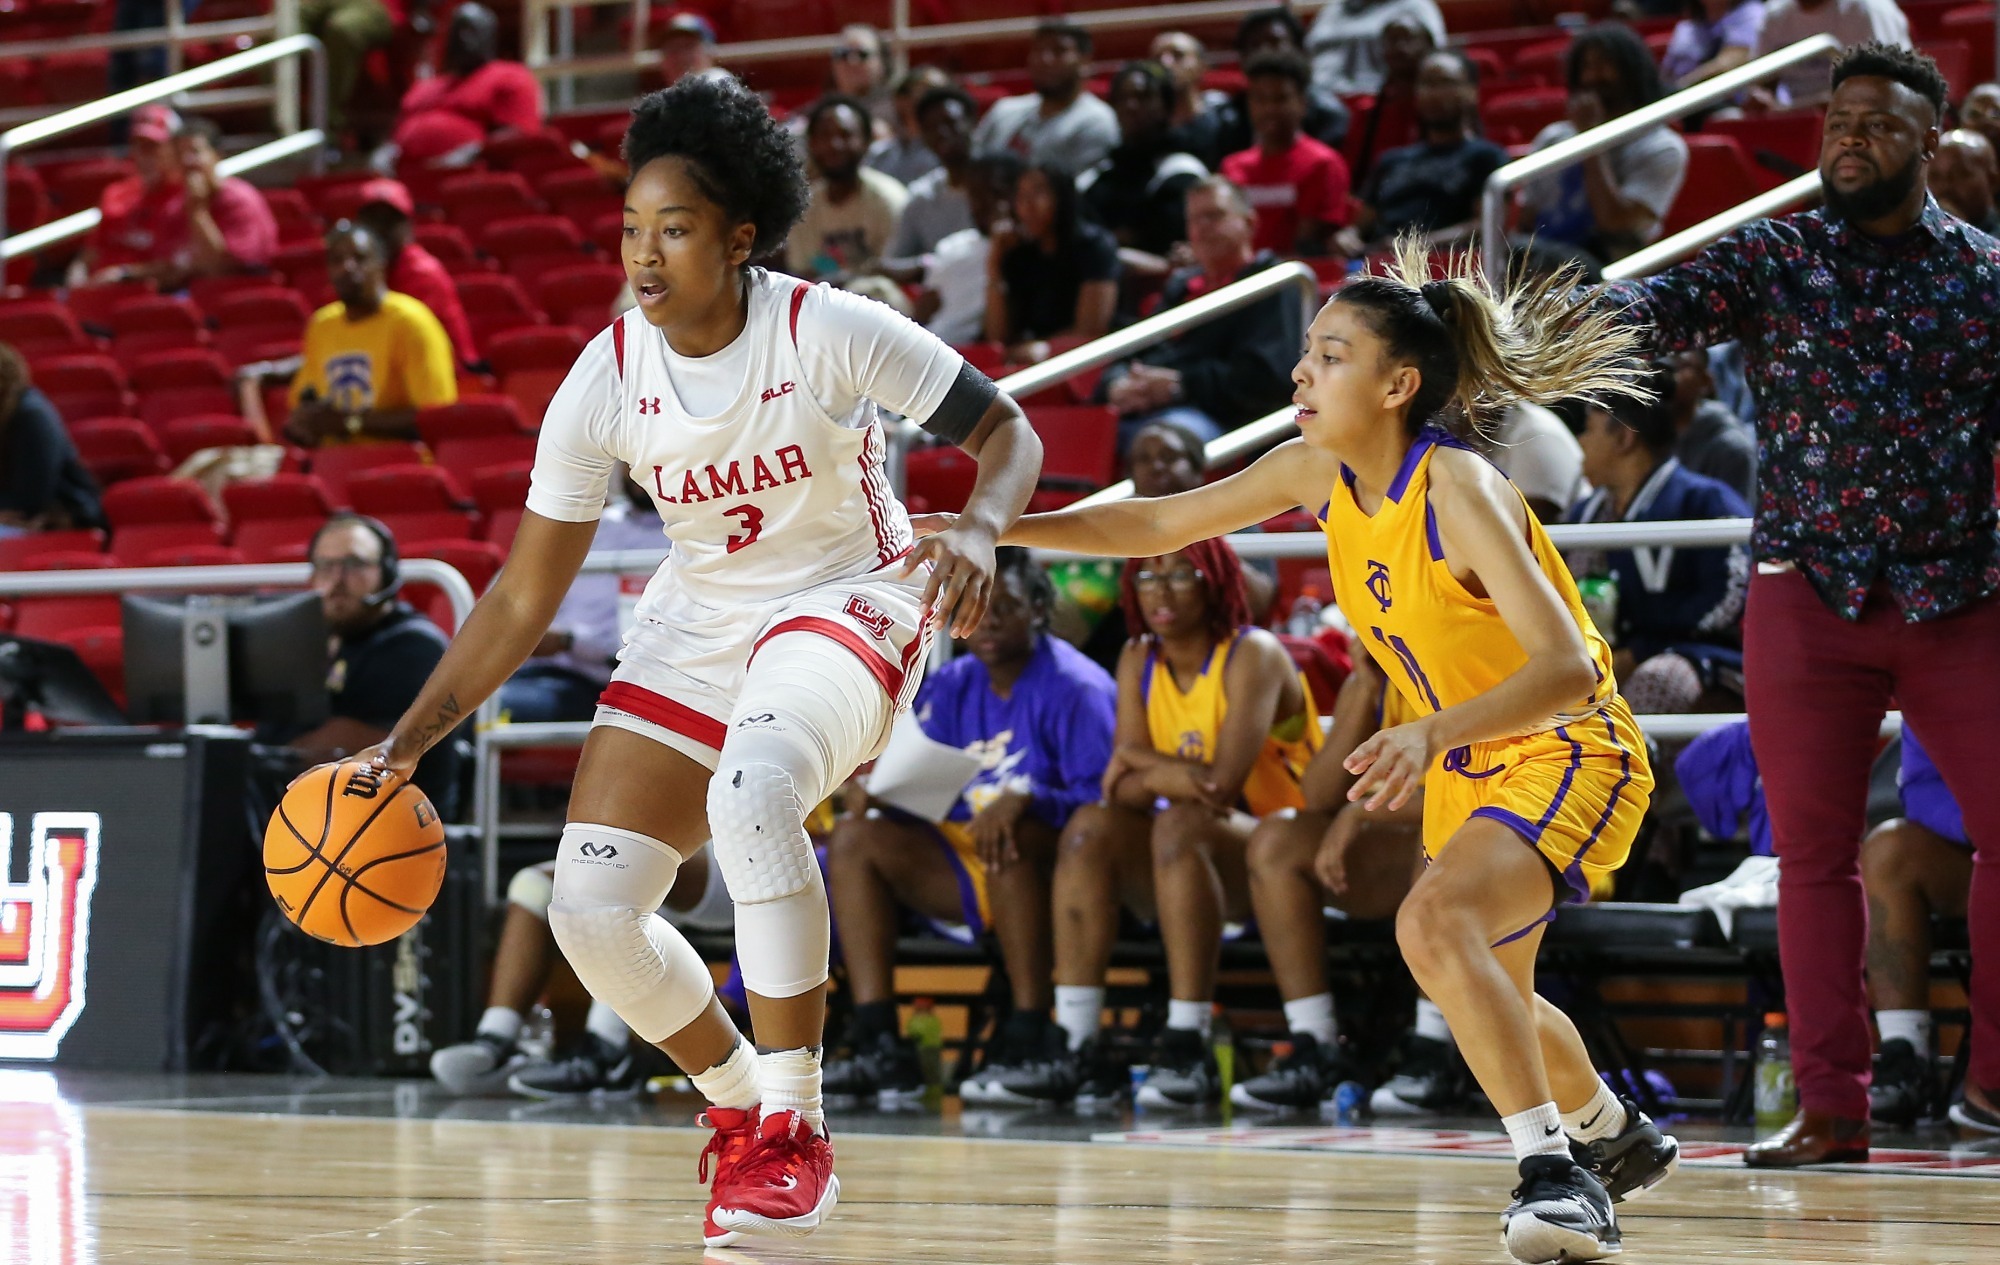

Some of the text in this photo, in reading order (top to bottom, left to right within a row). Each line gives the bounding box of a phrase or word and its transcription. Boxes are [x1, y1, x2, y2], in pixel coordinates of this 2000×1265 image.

[760, 380, 797, 404] SLC
[653, 444, 813, 504] LAMAR
[722, 503, 765, 554] 3
[1370, 625, 1443, 713] 11
